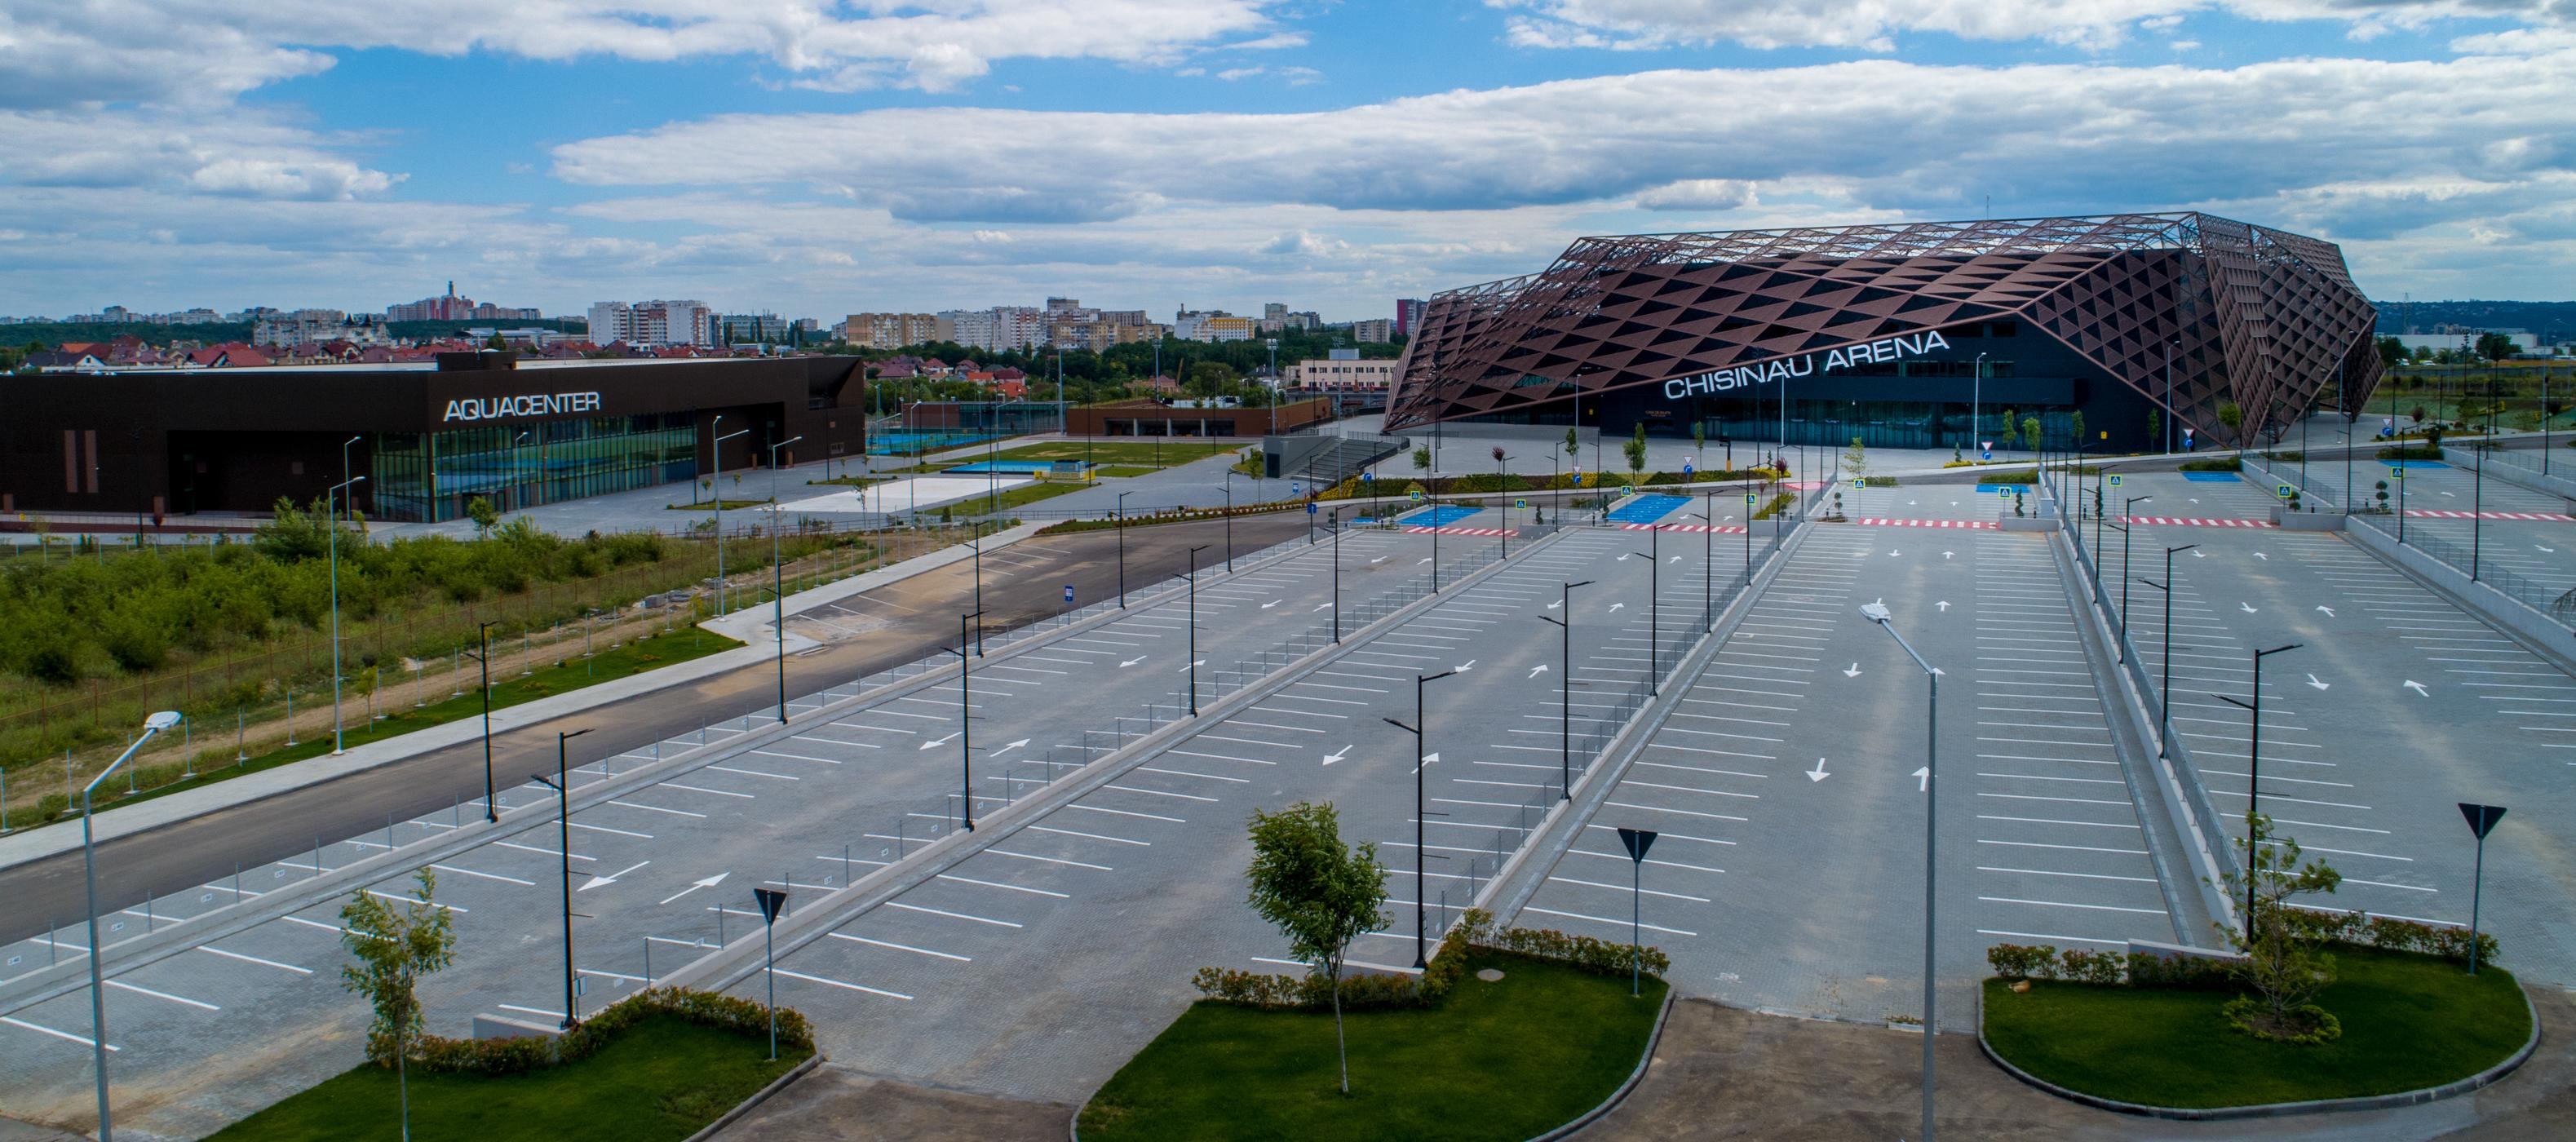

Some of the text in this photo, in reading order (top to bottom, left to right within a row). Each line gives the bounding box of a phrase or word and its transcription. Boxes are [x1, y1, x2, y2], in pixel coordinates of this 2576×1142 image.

[1665, 330, 1950, 399] CHISINAU ARENA
[443, 391, 600, 422] AQUACENTER
